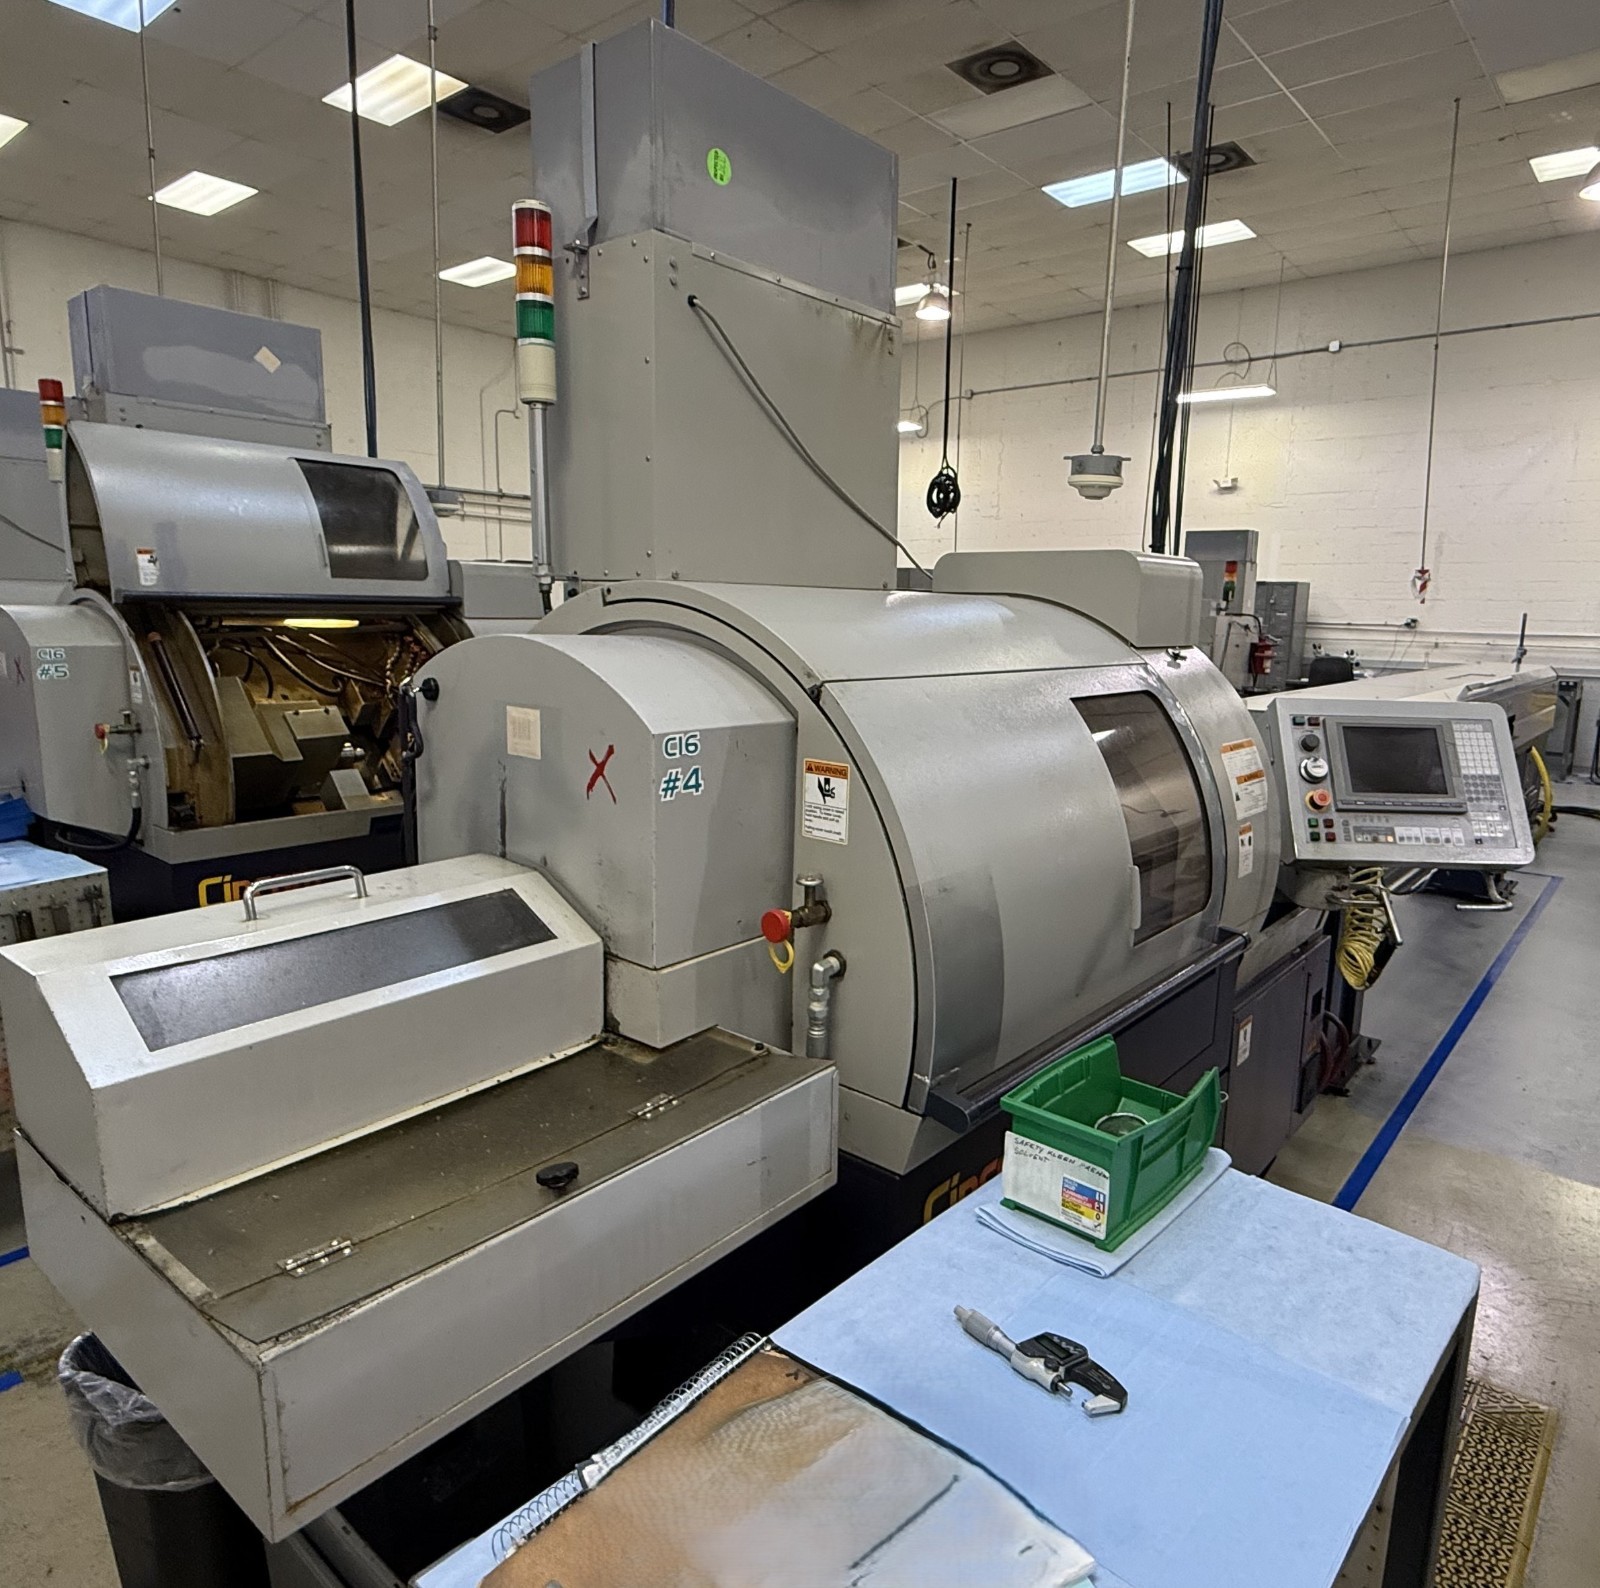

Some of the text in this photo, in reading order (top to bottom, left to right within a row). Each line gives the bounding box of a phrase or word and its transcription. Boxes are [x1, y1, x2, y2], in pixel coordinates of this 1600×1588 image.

[37, 663, 69, 680] #5
[814, 764, 847, 777] WARNING
[660, 766, 703, 801] #4
[1014, 1137, 1045, 1154] SAFETY
[1047, 1150, 1076, 1164] KLEEN
[1014, 1147, 1050, 1163] SOLVENT
